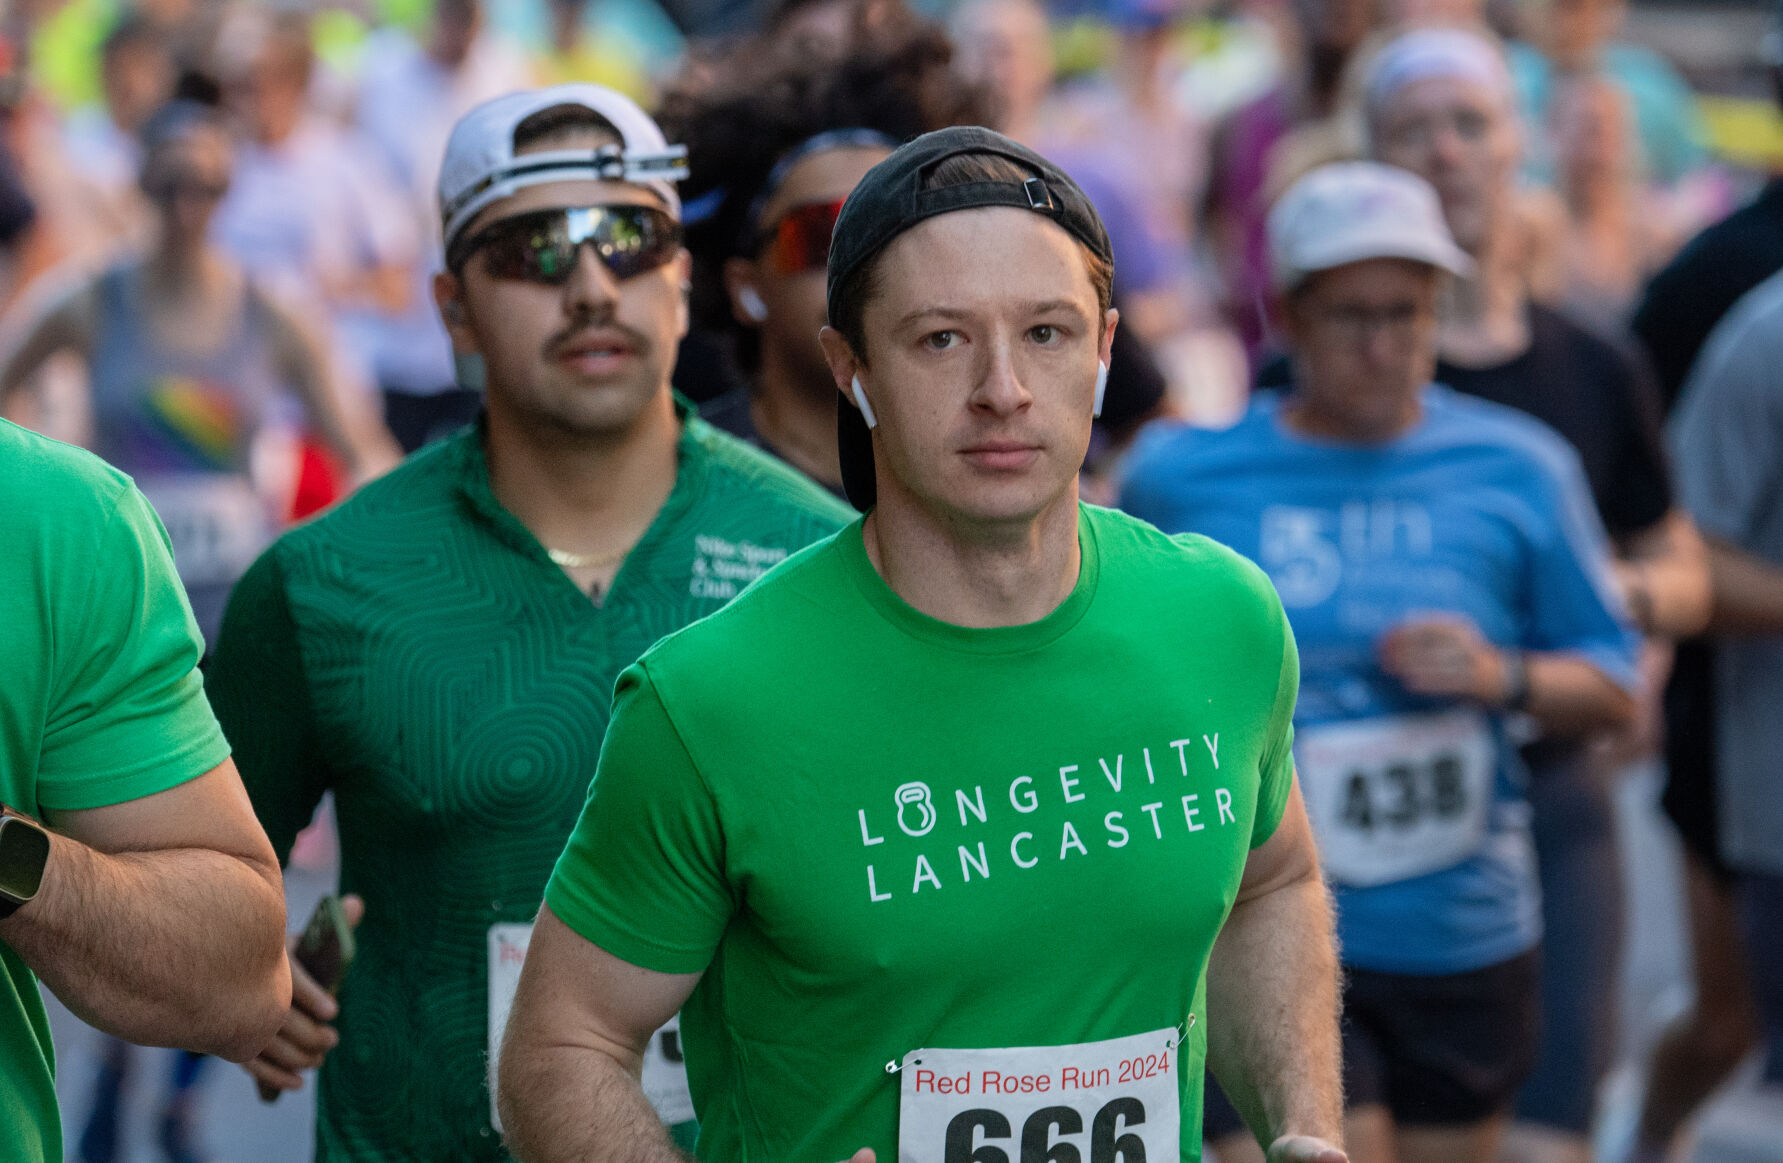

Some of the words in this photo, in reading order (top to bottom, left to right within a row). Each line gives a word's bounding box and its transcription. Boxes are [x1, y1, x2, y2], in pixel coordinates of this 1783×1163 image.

[867, 788, 1235, 902] LANCASTER
[916, 1070, 970, 1094] Red
[982, 1070, 1050, 1094] Rose
[1062, 1067, 1110, 1090] Run
[1118, 1051, 1170, 1083] 2024
[945, 1096, 1146, 1163] 666
